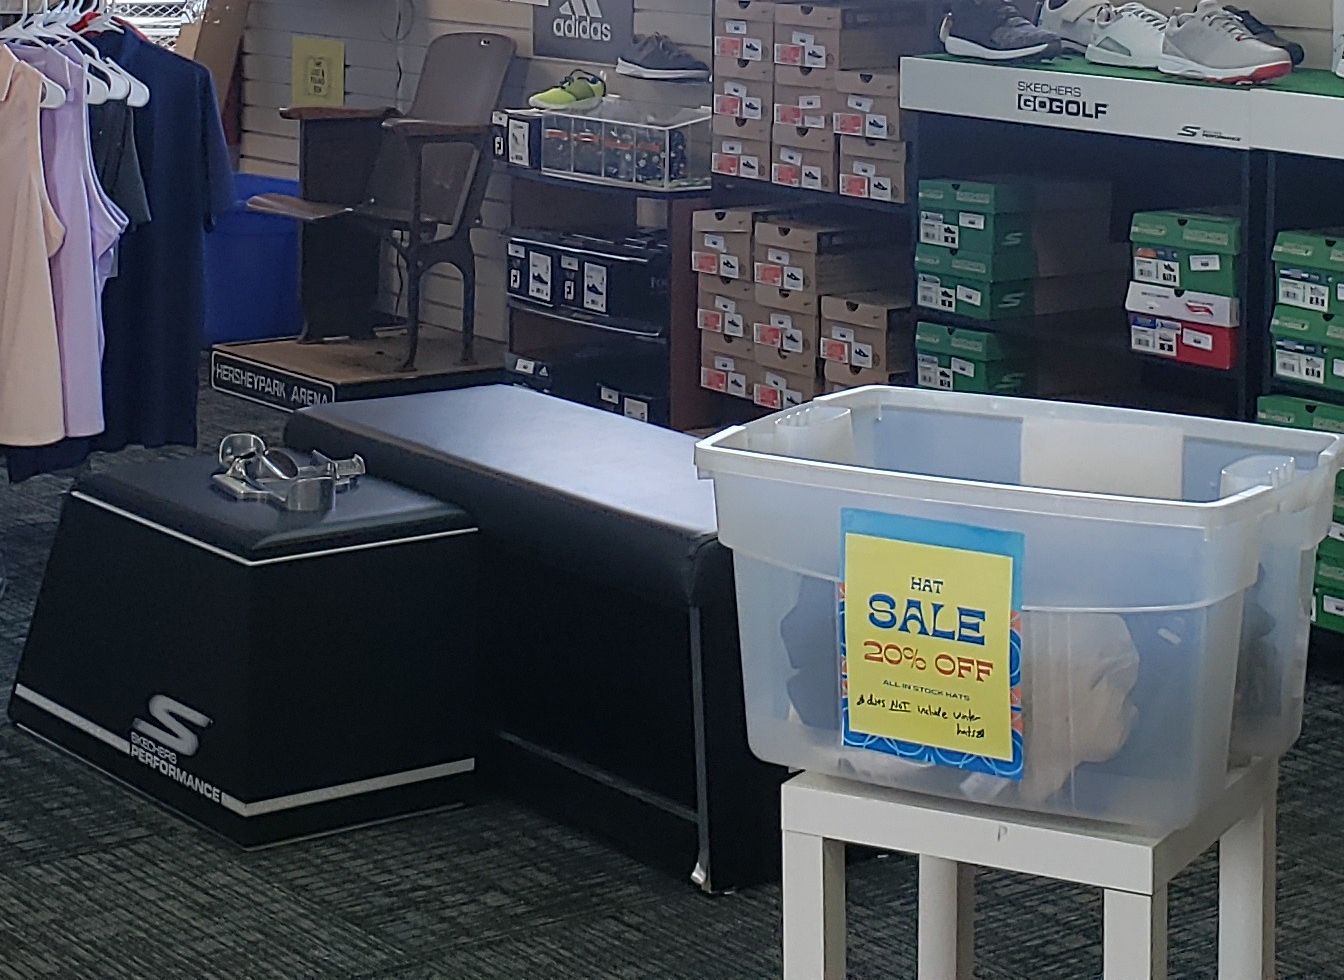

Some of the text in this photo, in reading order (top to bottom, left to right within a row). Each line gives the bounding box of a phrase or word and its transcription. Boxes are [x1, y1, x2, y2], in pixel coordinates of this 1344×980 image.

[553, 15, 611, 41] adidas
[1017, 80, 1081, 97] SKECHERS
[1017, 94, 1109, 119] GOGOLF
[216, 363, 328, 406] HERSHEYPARK ARENA
[910, 577, 944, 594] HAT
[868, 593, 986, 645] SALE
[863, 641, 994, 682] 20% OFF
[883, 680, 900, 688] ALL
[912, 685, 944, 696] STOCK
[945, 691, 970, 701] HATS
[889, 700, 911, 712] NOT
[131, 731, 177, 765] SKECHERS
[131, 744, 221, 803] PERFORMANCE
